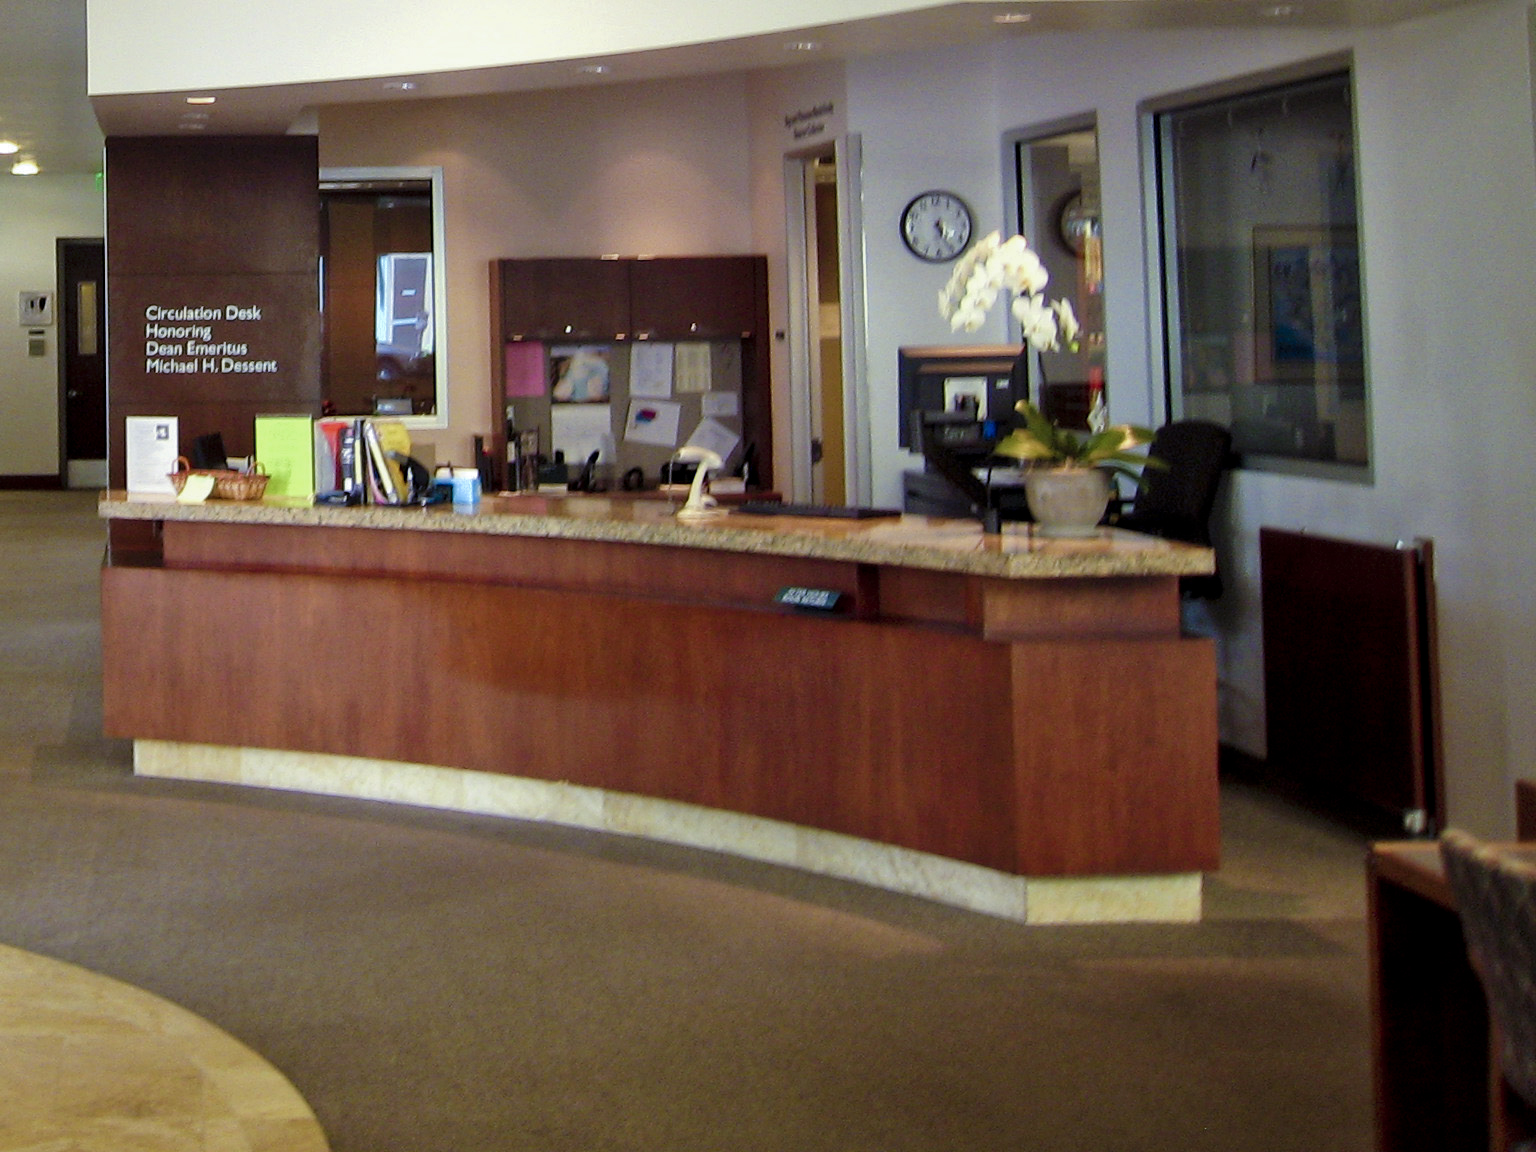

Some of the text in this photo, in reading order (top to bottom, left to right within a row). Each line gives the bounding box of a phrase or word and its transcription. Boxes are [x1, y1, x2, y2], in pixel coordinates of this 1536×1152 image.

[145, 305, 262, 321] Circulation Desk
[145, 323, 212, 342] Honoring
[145, 340, 248, 356] Dean Emeritus
[145, 357, 278, 374] Michael H. Dessent
